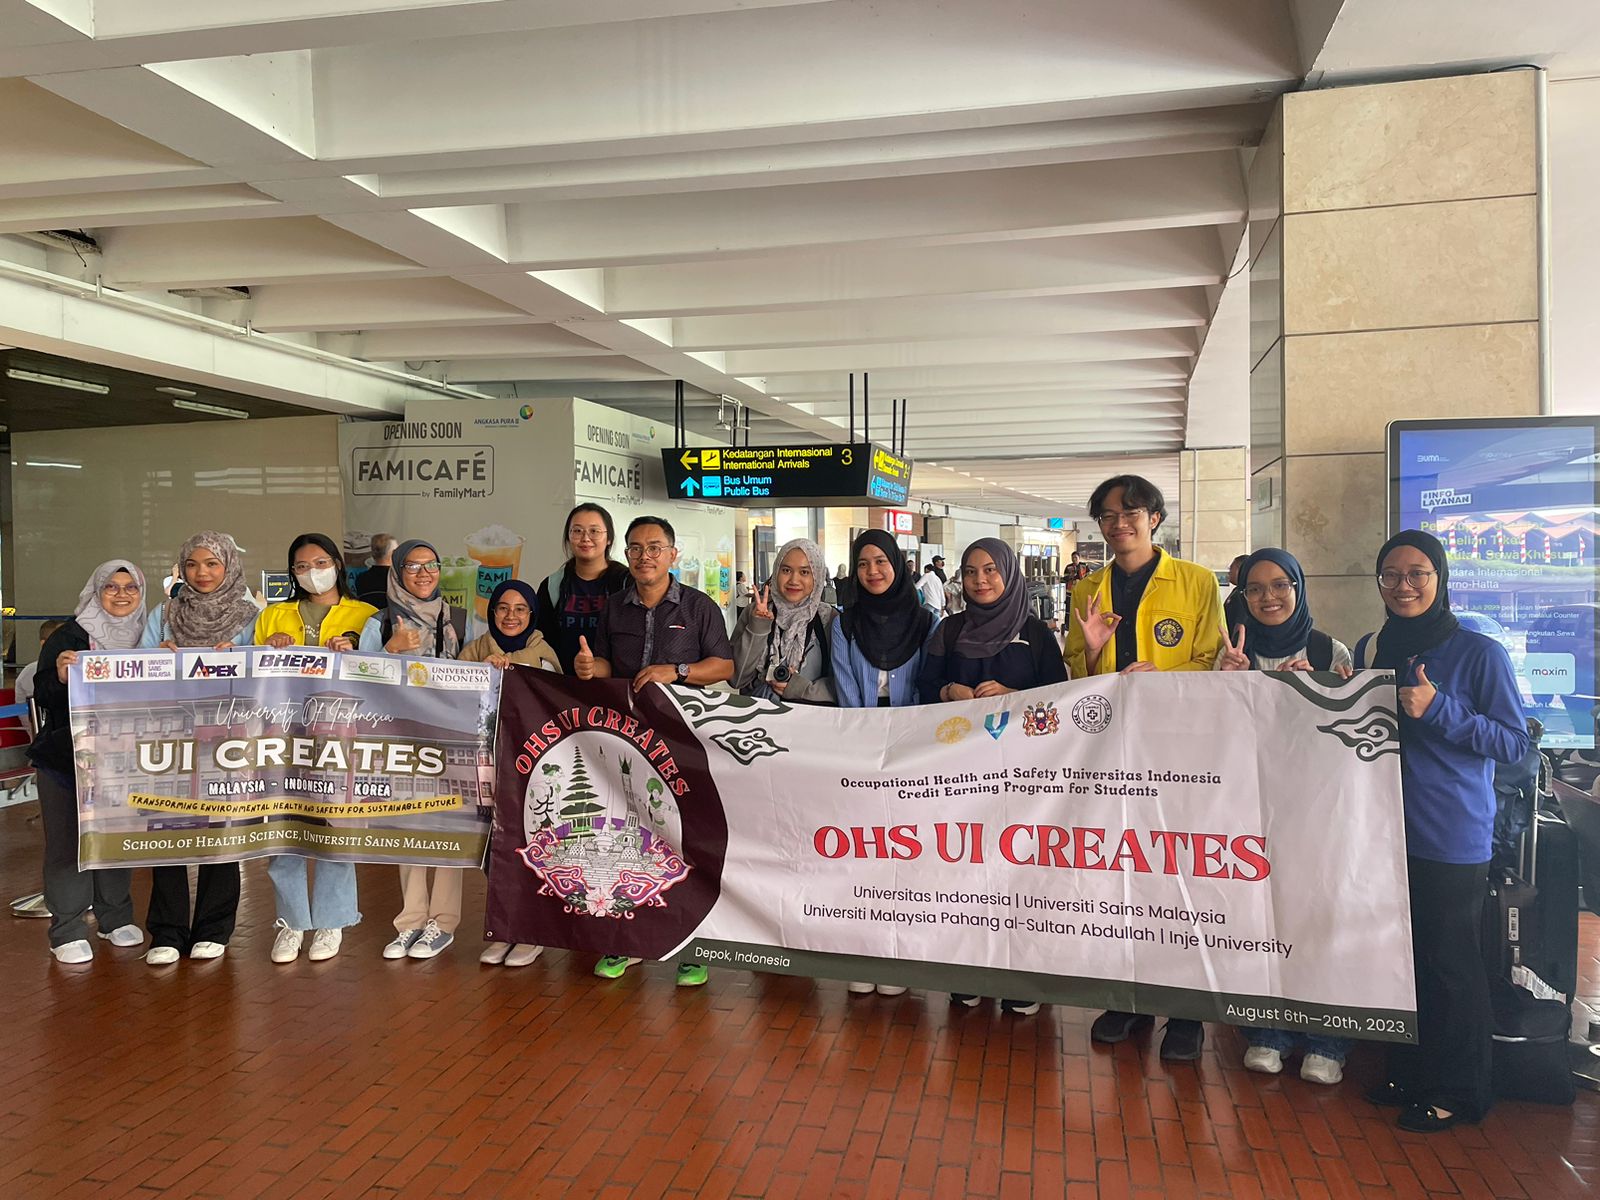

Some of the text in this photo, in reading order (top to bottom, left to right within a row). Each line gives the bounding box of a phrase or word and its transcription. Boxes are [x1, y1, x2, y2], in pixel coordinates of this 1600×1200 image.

[384, 422, 462, 440] OPENING SOON
[588, 425, 613, 446] OPENING
[615, 431, 630, 449] SOON
[722, 447, 853, 465] Kedatangan Internasional 3
[723, 459, 810, 470] International Arrivals
[358, 451, 486, 481] FAMICAFÉ
[574, 460, 640, 490] FAMICAFÉ
[723, 475, 772, 485] Bus Umum
[422, 488, 486, 499] by FamilyMart
[724, 486, 770, 496] Public Bus
[1423, 490, 1452, 500] #INFO
[1423, 496, 1470, 507] LAYANAN
[479, 571, 508, 582] FAMI
[1477, 567, 1543, 577] Internasional
[479, 584, 493, 593] CA
[442, 595, 463, 604] AMI
[188, 655, 238, 678] APEX
[259, 654, 328, 669] BHEPA
[301, 666, 327, 675] USM
[432, 666, 489, 676] UNIVERSITAS
[432, 674, 490, 683] INDONESIA
[1532, 667, 1567, 676] maxim
[217, 698, 302, 733] University
[329, 697, 394, 729] Indonesia
[138, 738, 445, 775] UI CREATES
[515, 706, 690, 796] OHS UI CREATES
[208, 779, 266, 796] MALAYSIA
[284, 777, 335, 795] INDONESIA
[354, 782, 391, 797] KOREA
[841, 767, 1222, 790] Occupational Health and Safety Universitas Indonesia
[898, 781, 1159, 800] Credit Earning Program for Students
[132, 795, 457, 814] TRANSFORMING ENVIRONMENTAL HEALTH AND SAFETY FOR SUSTAINABLE FUTURE
[813, 822, 1271, 881] OHS UI CREATES
[853, 885, 931, 902] Universitas
[936, 891, 1011, 906] Indonesia
[1024, 895, 1094, 913] Universiti
[1100, 901, 1144, 917] Sains
[1149, 904, 1225, 926] Malaysia
[803, 904, 866, 920] Universiti
[871, 908, 936, 926] Malaysia
[941, 911, 999, 932] Pahang
[1004, 917, 1076, 935] al-Sultan
[1081, 923, 1155, 942] Abdullah
[1170, 931, 1200, 949] Inje
[1205, 934, 1293, 959] University
[695, 946, 791, 967] Depok, Indonesia
[1226, 1004, 1280, 1022] August
[1366, 1018, 1405, 1034] 2023
